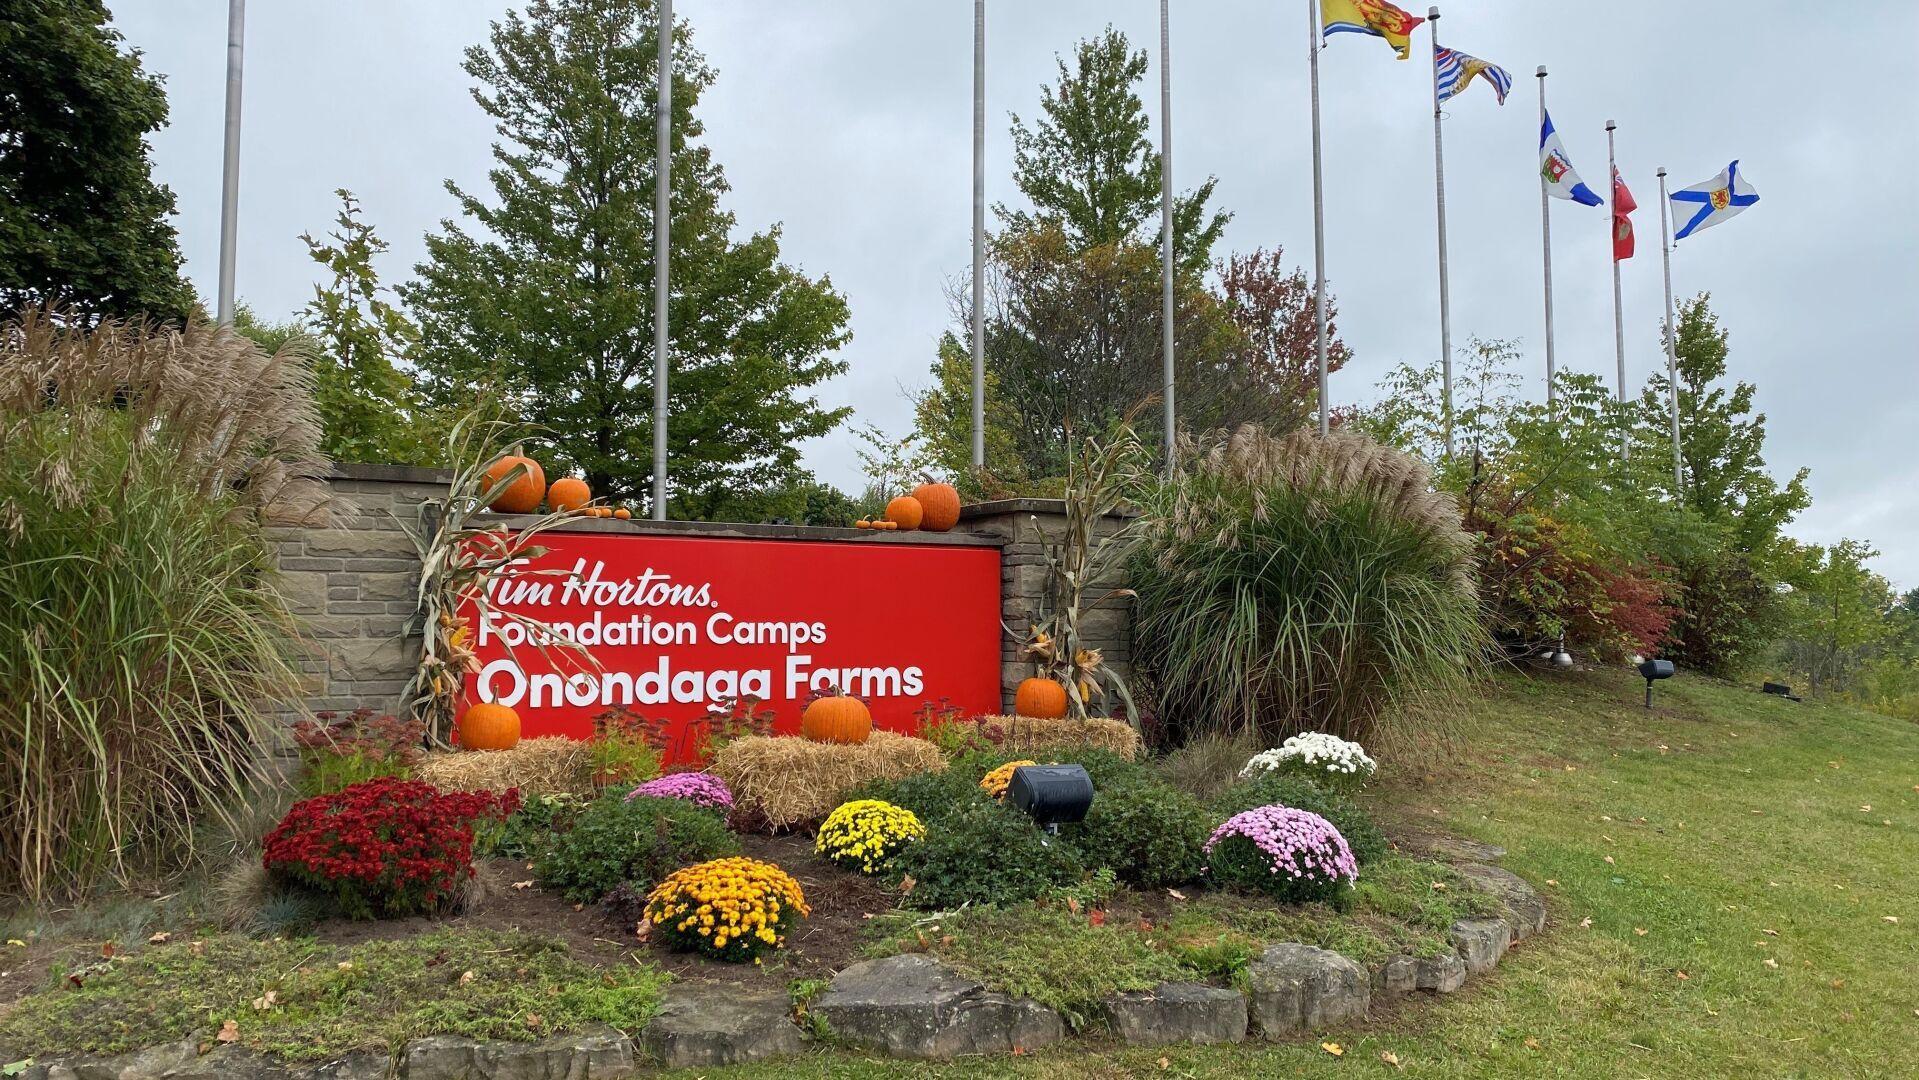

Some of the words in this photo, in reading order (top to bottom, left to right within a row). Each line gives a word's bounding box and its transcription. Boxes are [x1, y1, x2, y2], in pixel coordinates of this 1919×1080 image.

[480, 611, 697, 646] Foundation
[706, 612, 827, 653] Camps
[477, 656, 771, 713] Onondaga
[786, 655, 924, 700] Farms
